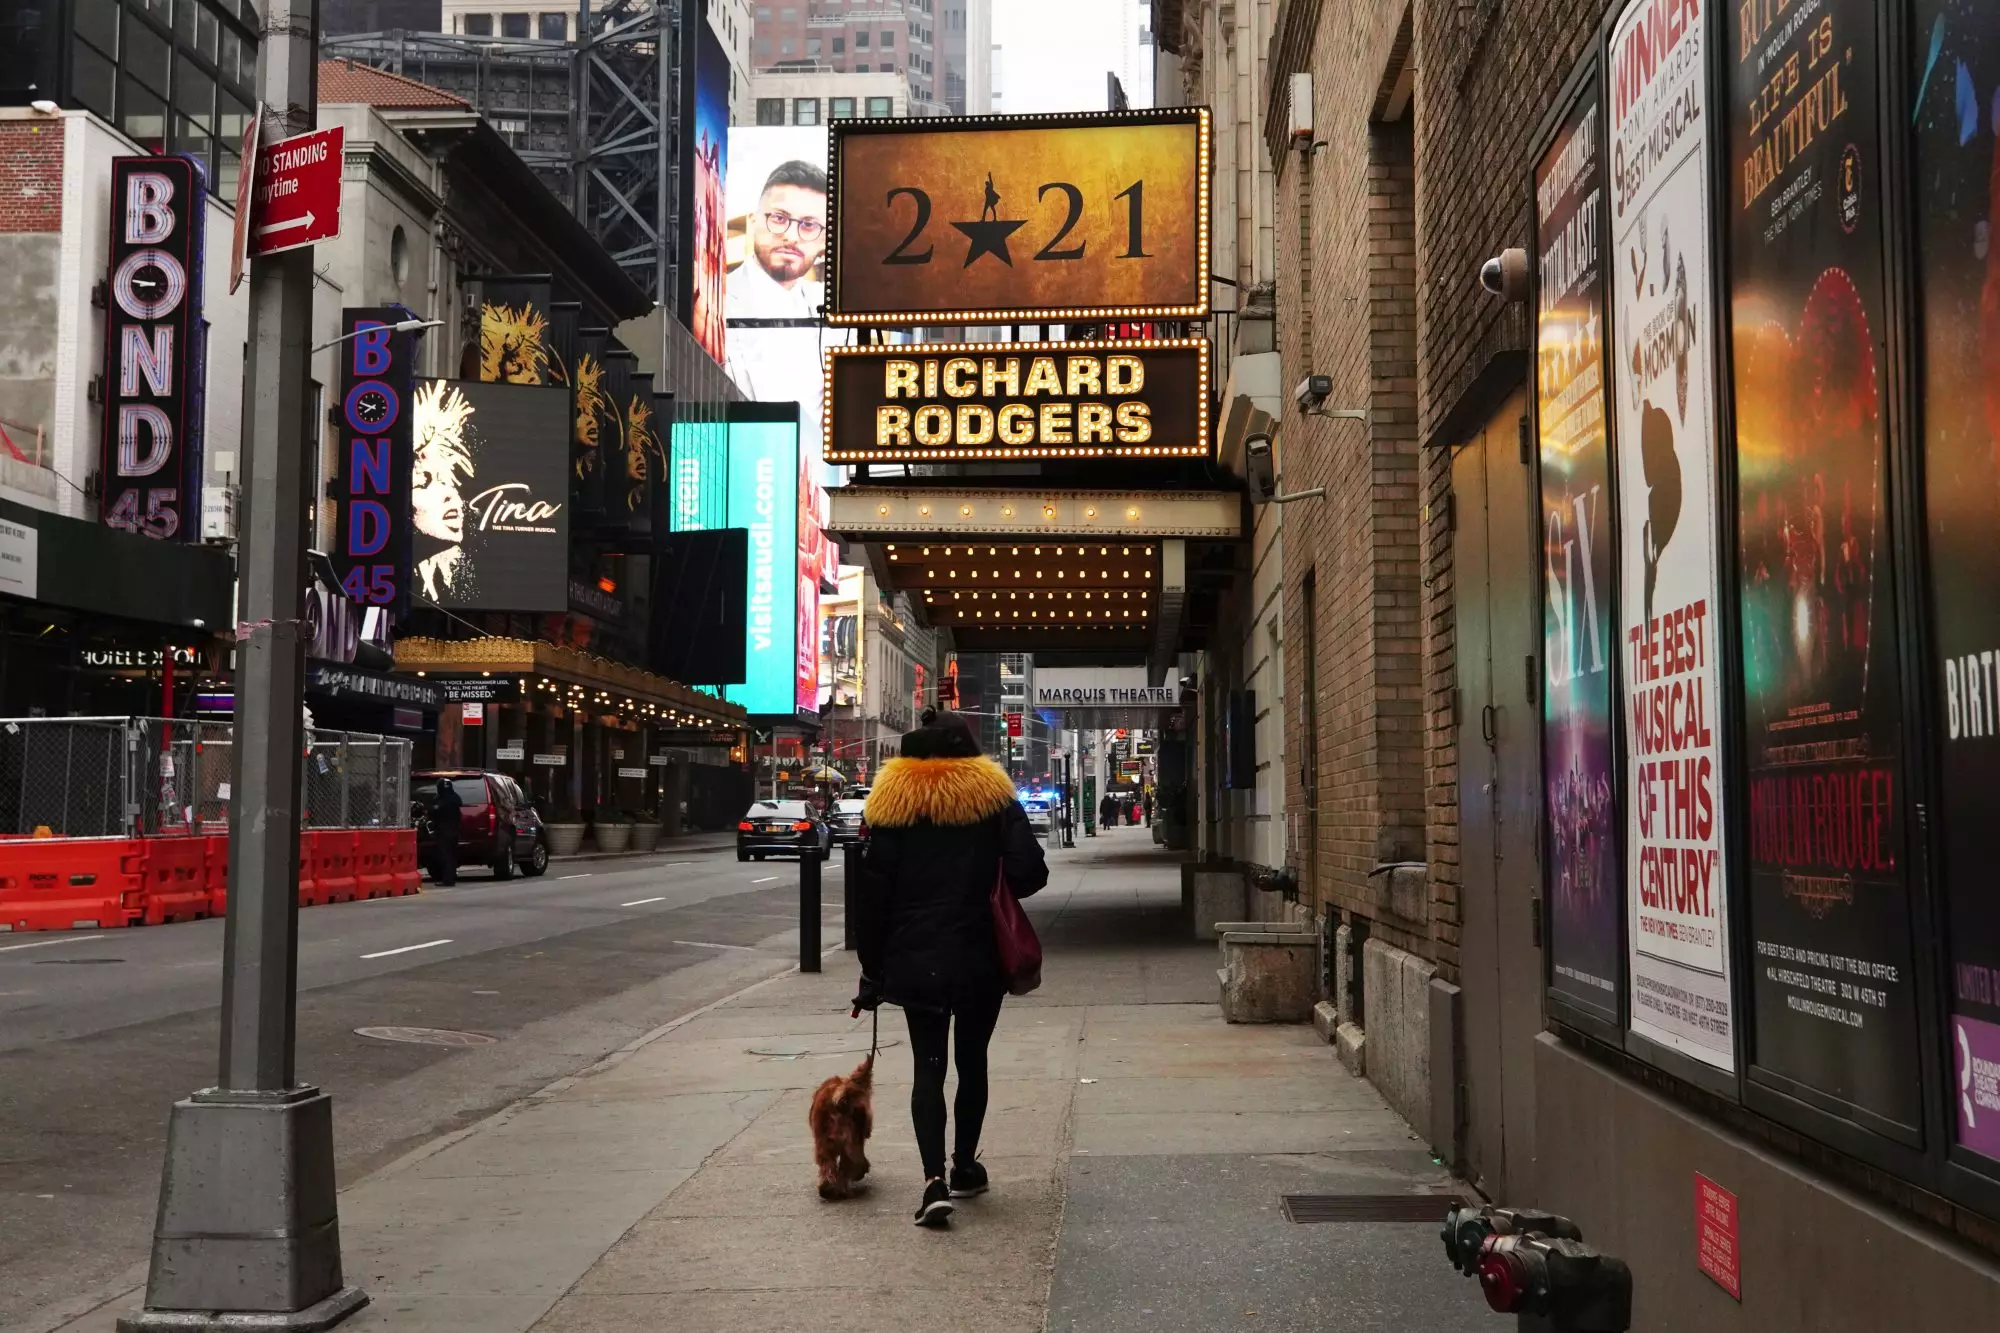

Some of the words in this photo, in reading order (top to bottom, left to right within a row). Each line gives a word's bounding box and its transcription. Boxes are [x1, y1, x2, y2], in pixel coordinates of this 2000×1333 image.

[1623, 102, 1648, 152] TONY
[1654, 27, 1700, 108] AWARDS
[1749, 50, 1799, 137] LIFE
[1808, 13, 1832, 70] IS
[273, 140, 328, 174] STANDING
[1626, 142, 1647, 207] BEST
[1648, 79, 1700, 174] MUSICAL
[255, 176, 299, 204] Anytime
[1615, 137, 1625, 219] 9
[1545, 230, 1567, 314] TOTAL
[113, 171, 187, 477] BOND
[884, 355, 1146, 400] RICHARD
[345, 320, 400, 557] BOND
[876, 401, 1153, 447] RODGERS
[104, 487, 180, 539] 45
[468, 482, 562, 532] Tina
[534, 526, 557, 534] MUSICAL
[342, 564, 396, 604] 45
[1548, 483, 1605, 688] SIX
[1663, 599, 1706, 678] BEST
[449, 690, 459, 698] BE
[461, 690, 496, 698] MISSED."
[1039, 688, 1106, 702] MARQUIS
[1110, 688, 1173, 701] THEATRE
[1633, 676, 1711, 756] MUSICAL
[1638, 761, 1657, 839] OF
[1660, 755, 1713, 842] THIS
[1750, 774, 1812, 867] MOULIN
[1813, 769, 1896, 872] ROUGE!
[1757, 940, 1767, 955] FOR
[1767, 942, 1779, 957] BEST
[1779, 944, 1795, 960] SEATS
[1795, 949, 1806, 963] AND
[1806, 950, 1829, 968] PRICING
[1829, 954, 1845, 971] VISIT
[1845, 957, 1858, 975] THE
[1858, 960, 1871, 977] BOX
[1778, 968, 1810, 989] HIRSCHFELD
[1810, 975, 1837, 996] THEATRE
[1840, 982, 1852, 1000] 302
[1878, 991, 1887, 1009] ST
